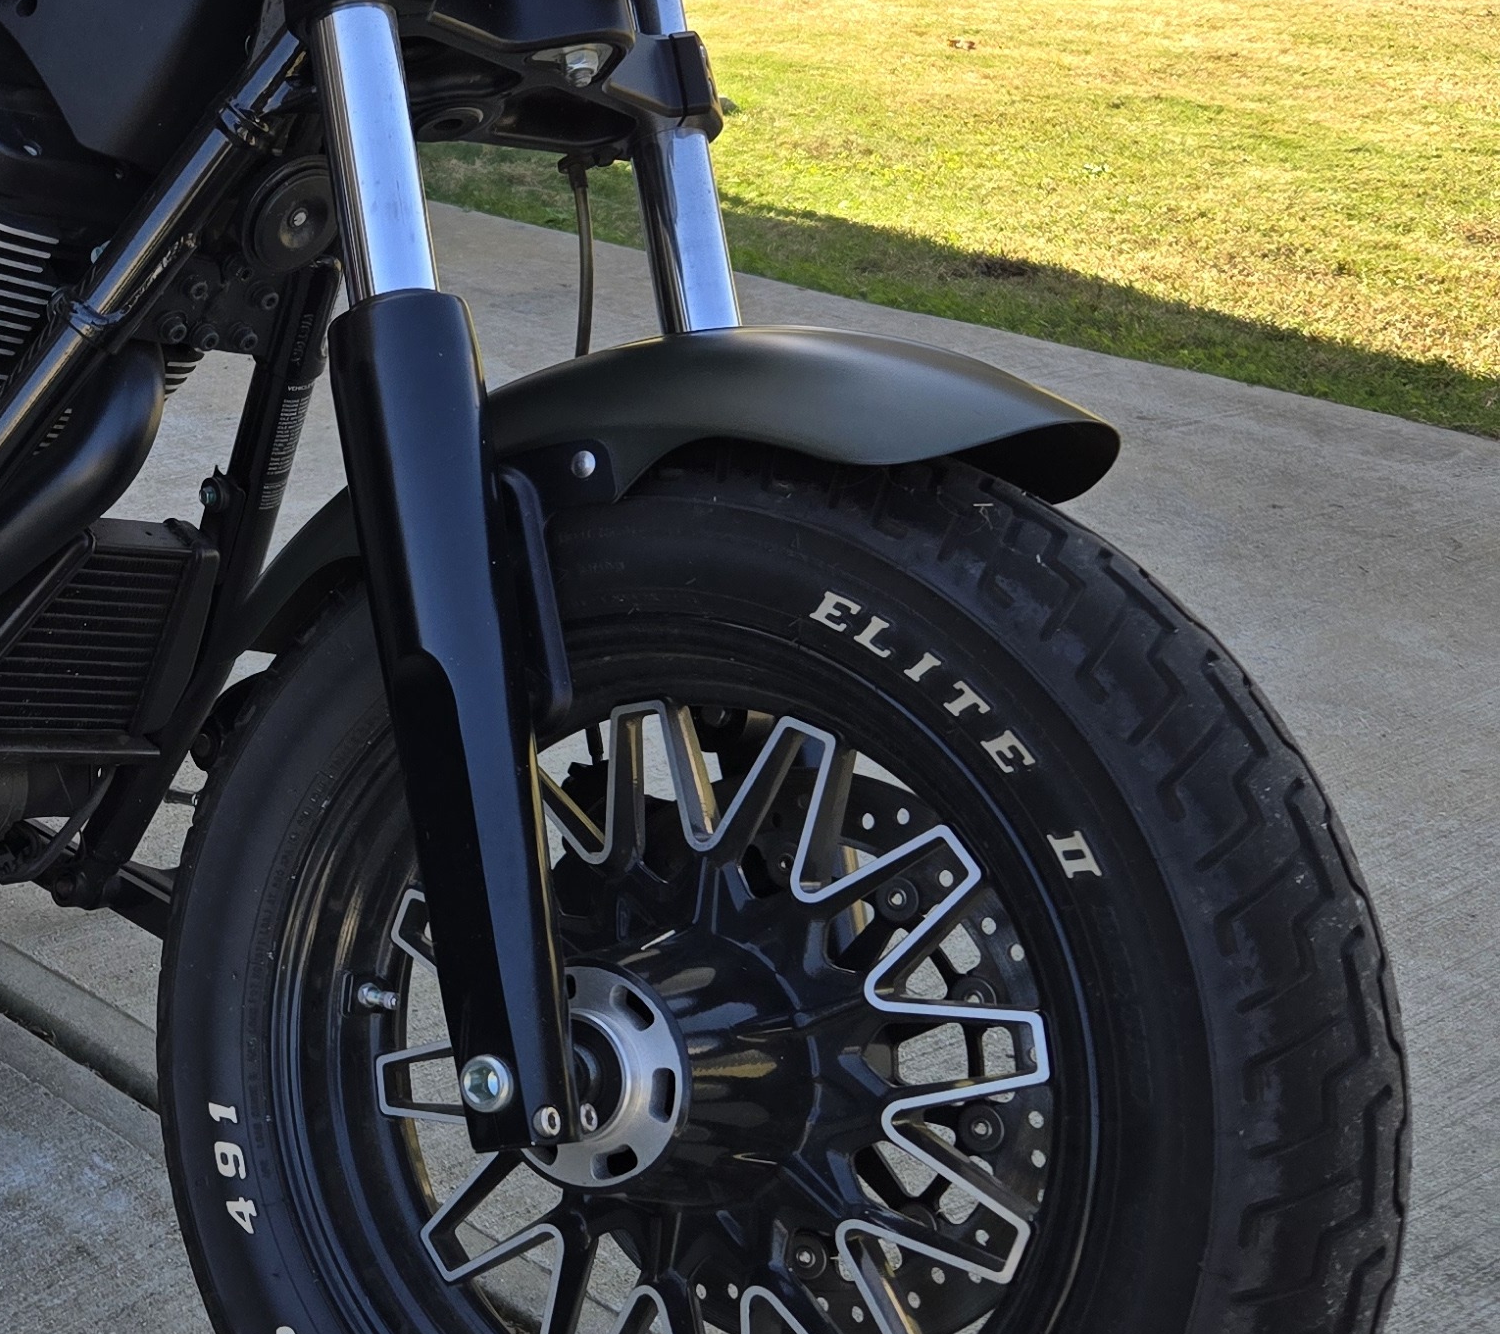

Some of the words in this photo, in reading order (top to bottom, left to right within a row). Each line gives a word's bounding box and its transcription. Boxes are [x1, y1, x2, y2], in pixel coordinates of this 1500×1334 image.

[808, 590, 1037, 774] ELITE
[1046, 829, 1103, 880] II
[208, 1101, 259, 1236] 491
